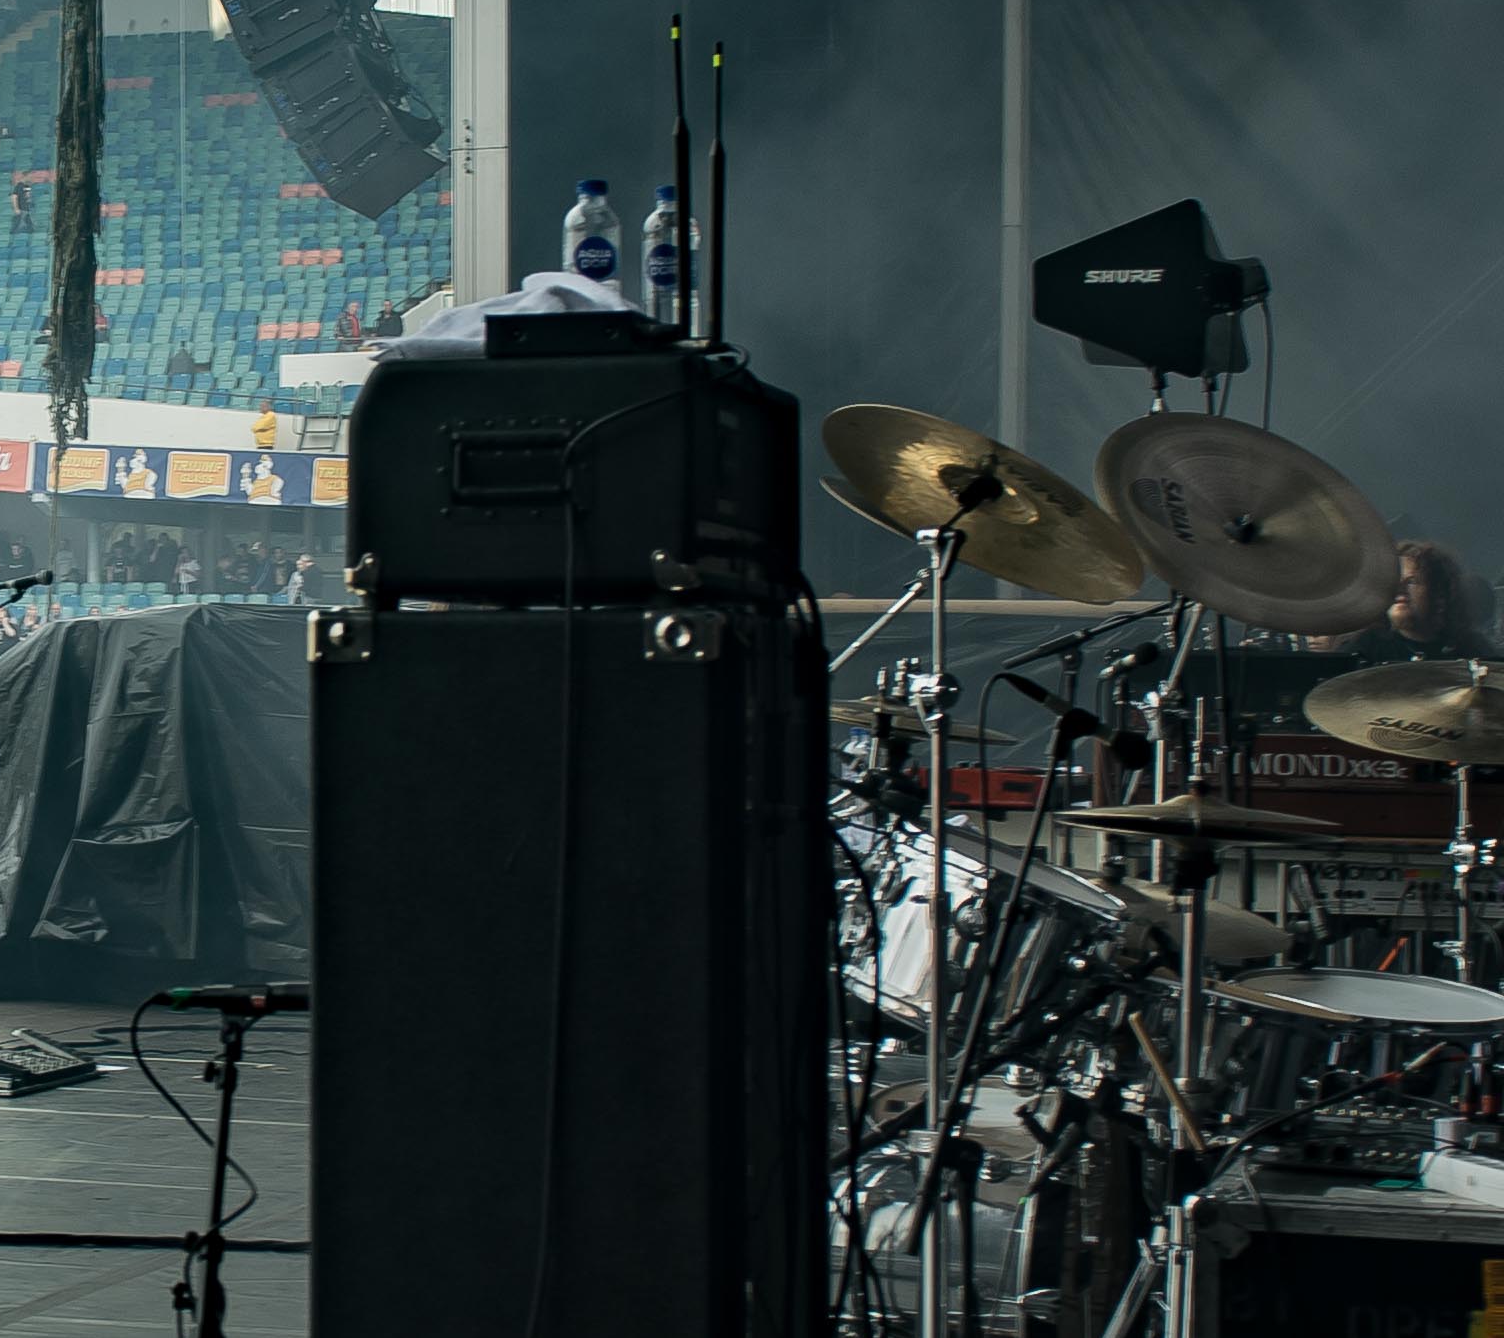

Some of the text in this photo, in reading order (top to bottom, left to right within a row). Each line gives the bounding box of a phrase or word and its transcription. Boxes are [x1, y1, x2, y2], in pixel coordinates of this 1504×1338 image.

[1084, 269, 1165, 283] SHURE
[319, 466, 348, 479] TRIU
[1368, 716, 1465, 741] SABIAN
